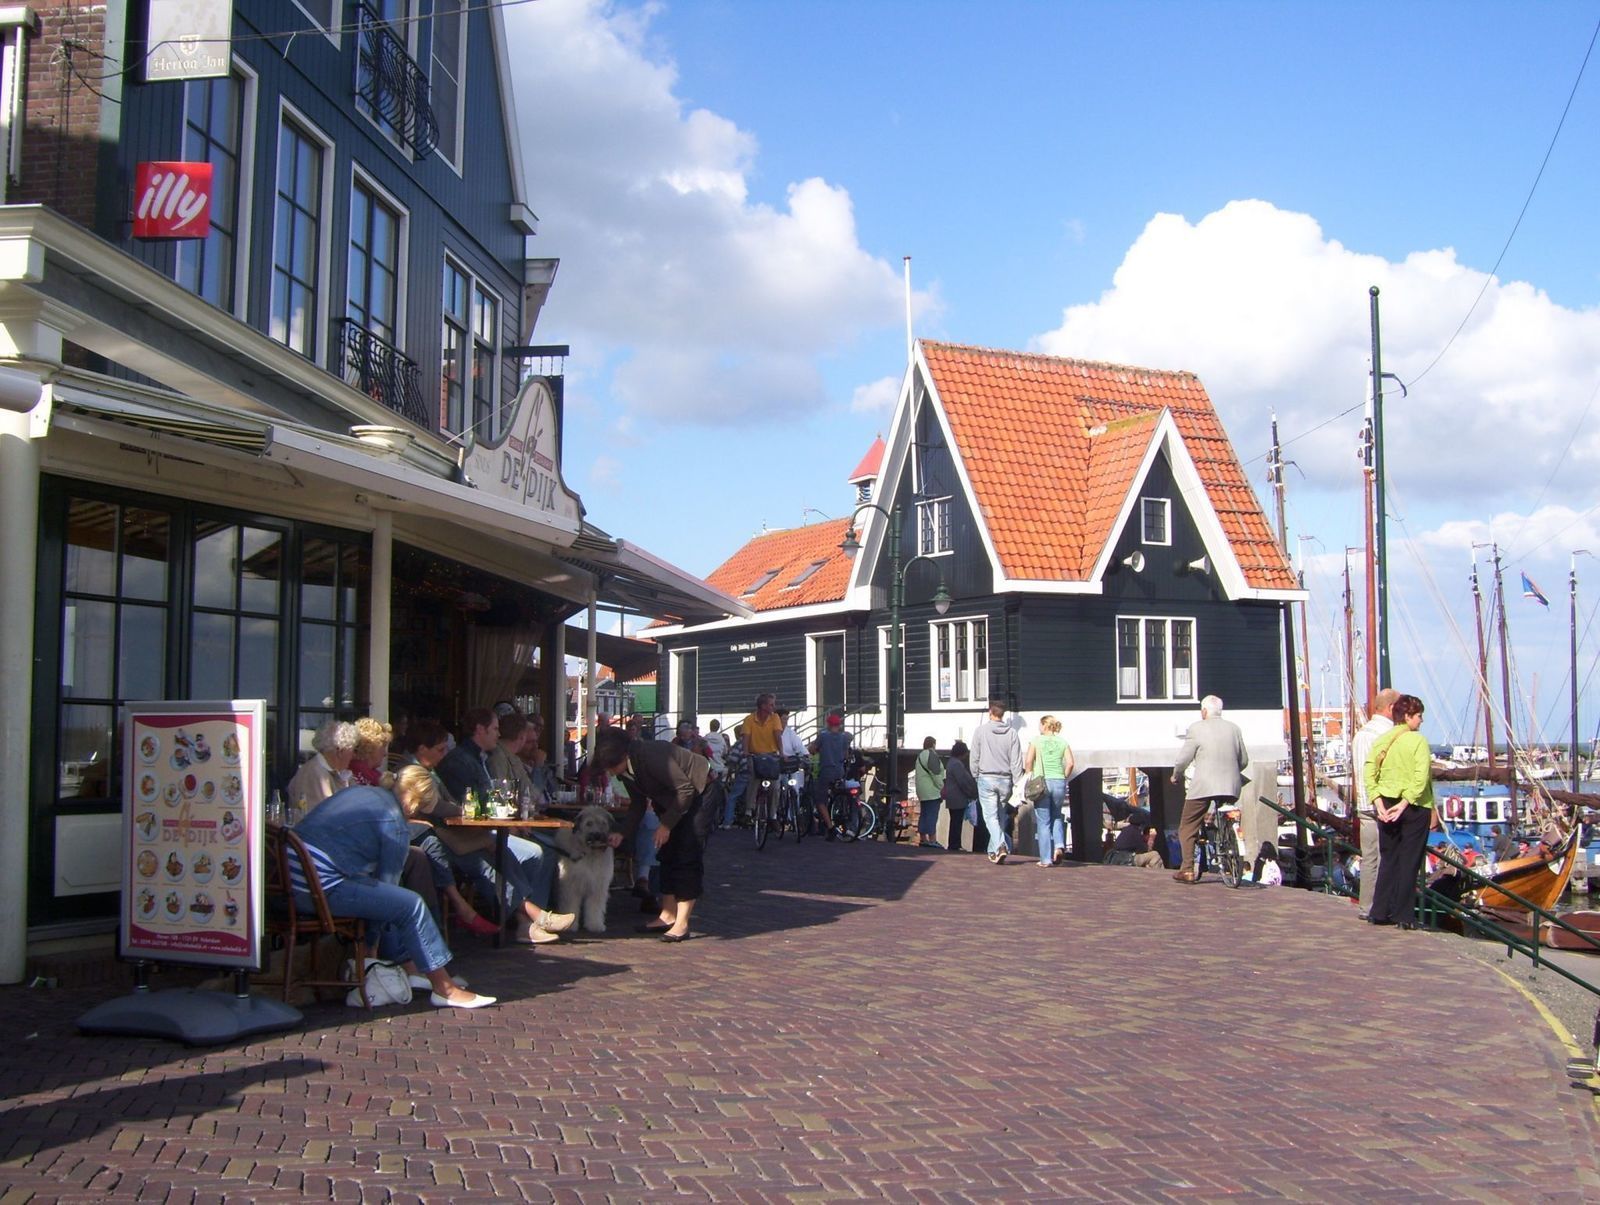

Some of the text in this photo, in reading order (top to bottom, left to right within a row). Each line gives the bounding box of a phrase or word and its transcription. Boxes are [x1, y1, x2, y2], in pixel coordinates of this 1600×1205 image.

[201, 55, 225, 68] Jan
[138, 172, 207, 231] illy
[501, 451, 521, 490] DE
[527, 466, 557, 511] DIJK
[162, 829, 218, 847] DE DIJK
